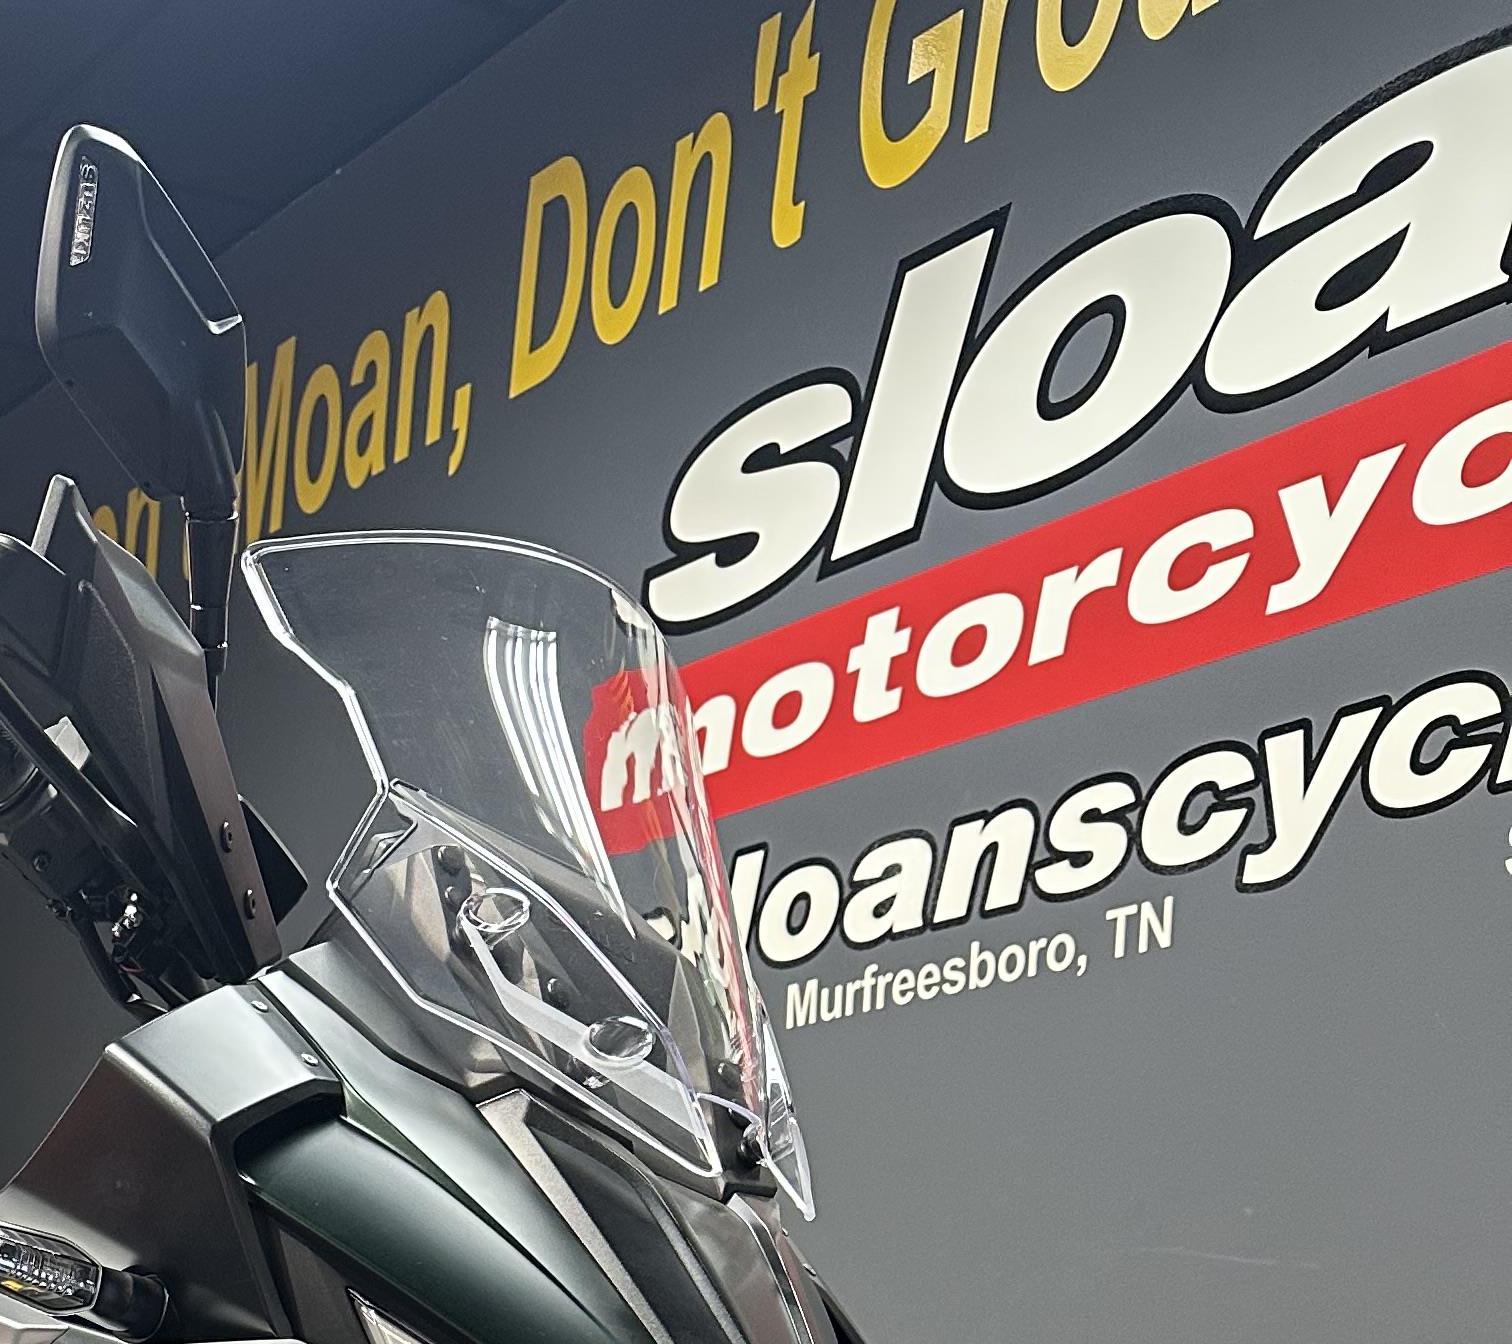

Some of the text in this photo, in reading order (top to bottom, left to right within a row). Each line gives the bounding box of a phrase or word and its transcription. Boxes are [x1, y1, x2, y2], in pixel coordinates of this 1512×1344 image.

[235, 290, 472, 545] Moan,
[509, 0, 819, 399] Don't
[785, 895, 1175, 1029] Murfreesboro, TN
